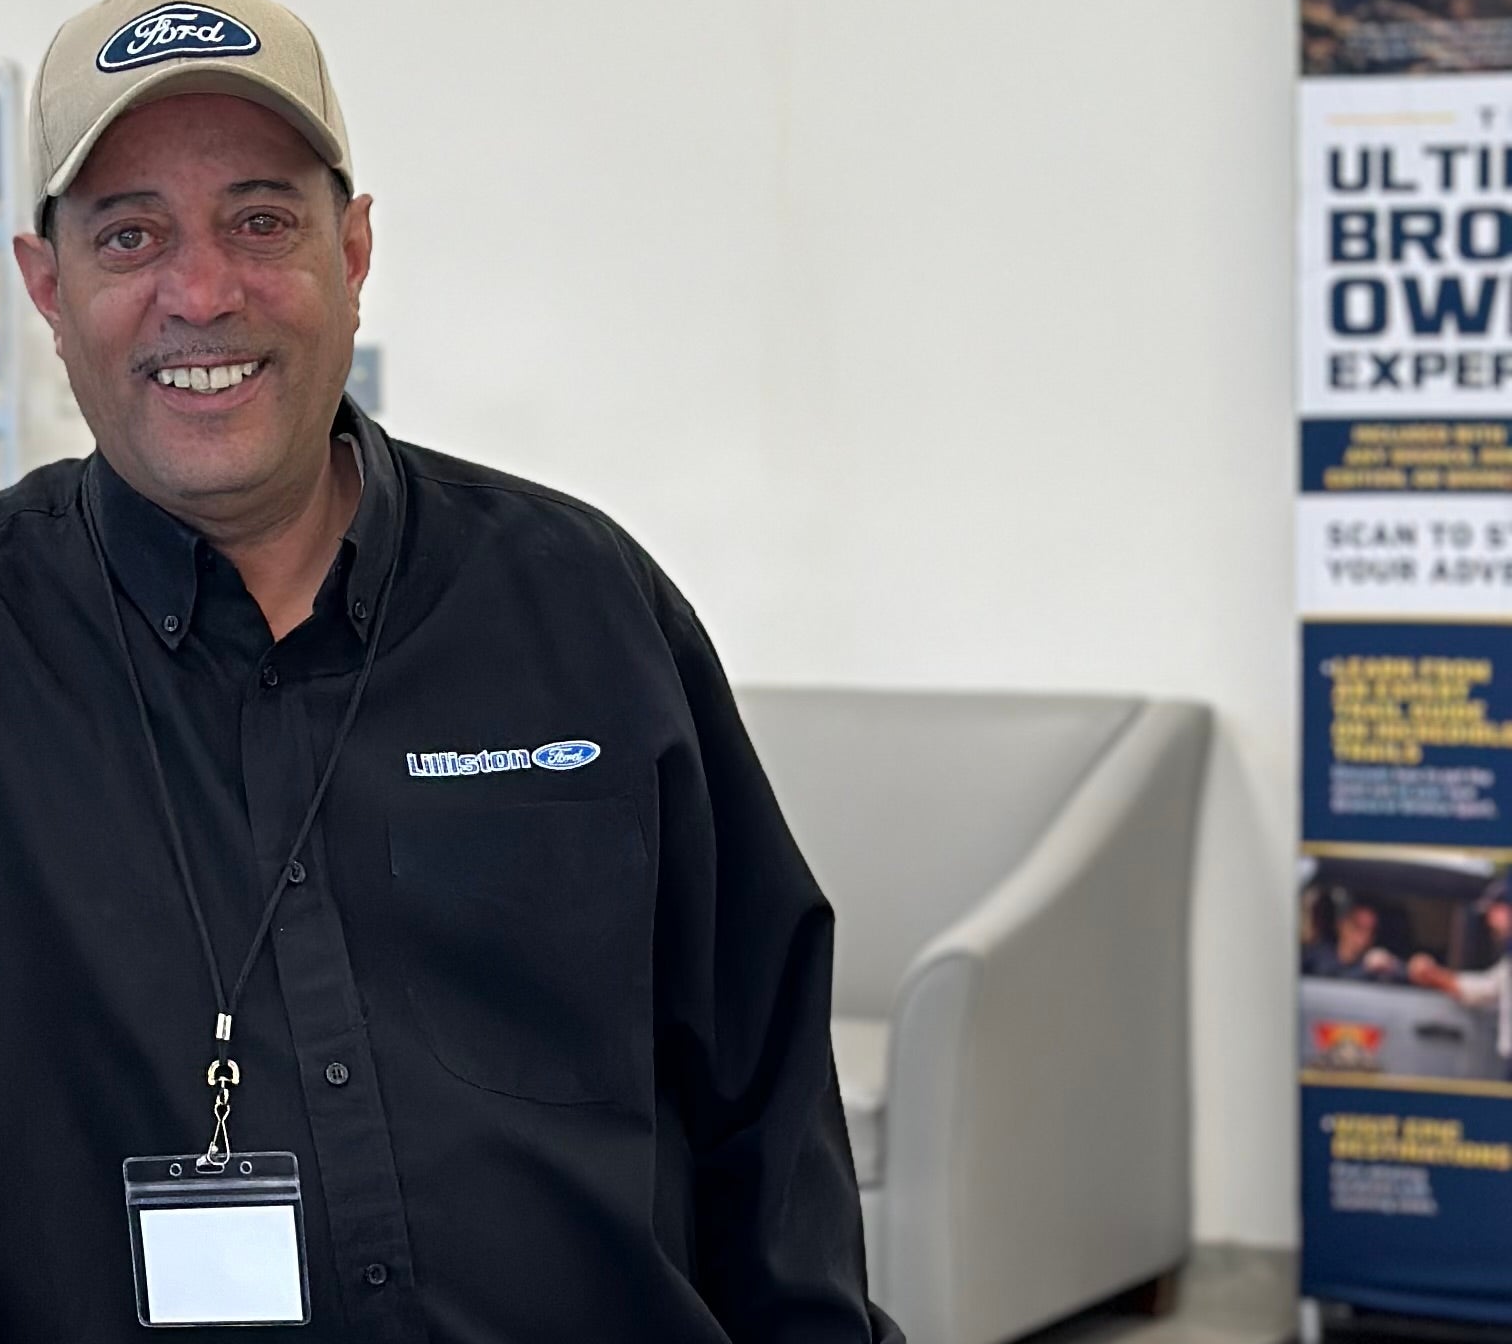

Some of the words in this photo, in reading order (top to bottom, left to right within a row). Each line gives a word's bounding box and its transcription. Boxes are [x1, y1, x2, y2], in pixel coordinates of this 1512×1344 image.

[126, 13, 225, 54] Ford
[1328, 144, 1512, 193] ULTI
[1330, 275, 1512, 338] OW
[1326, 522, 1416, 549] SCAN
[1432, 522, 1474, 549] TO
[407, 749, 531, 776] Lilliston
